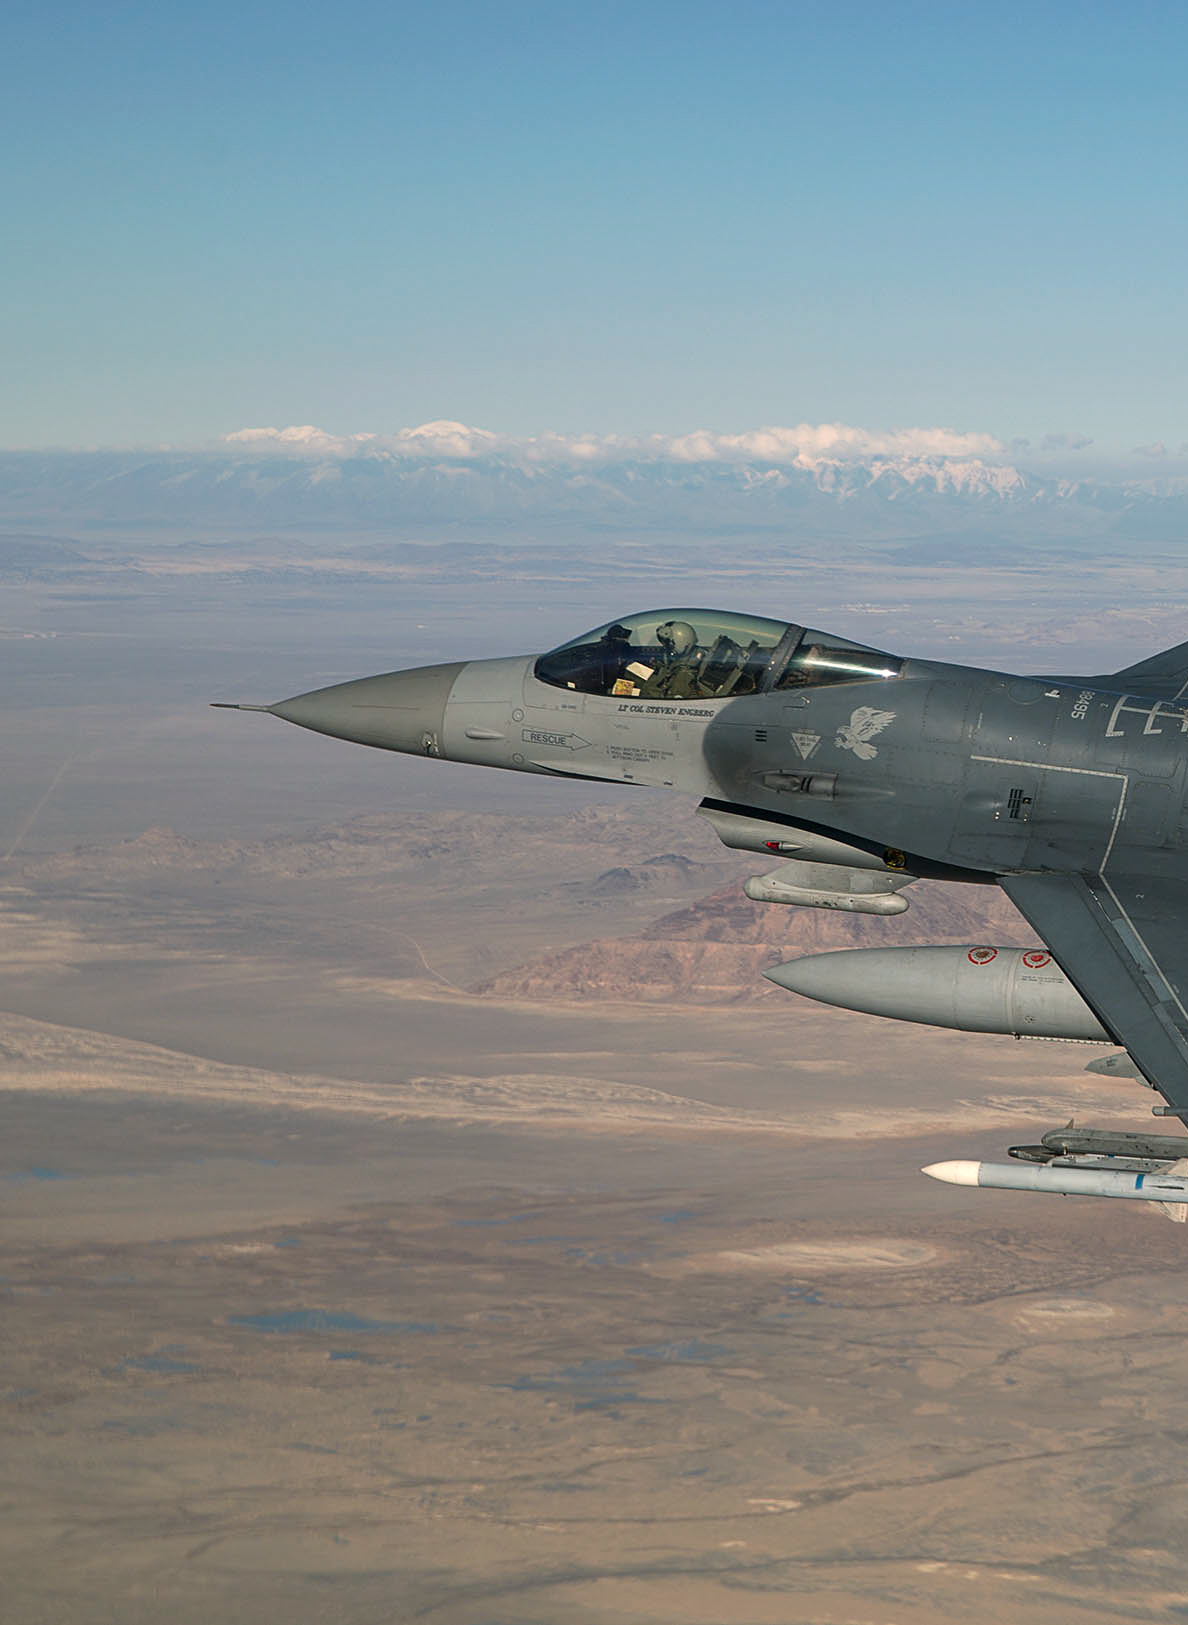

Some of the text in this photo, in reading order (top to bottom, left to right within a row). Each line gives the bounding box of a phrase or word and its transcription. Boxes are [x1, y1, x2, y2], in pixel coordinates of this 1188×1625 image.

[618, 704, 629, 712] LT
[629, 705, 645, 713] COL
[646, 706, 677, 715] STEVEN
[530, 733, 567, 745] RESCUE
